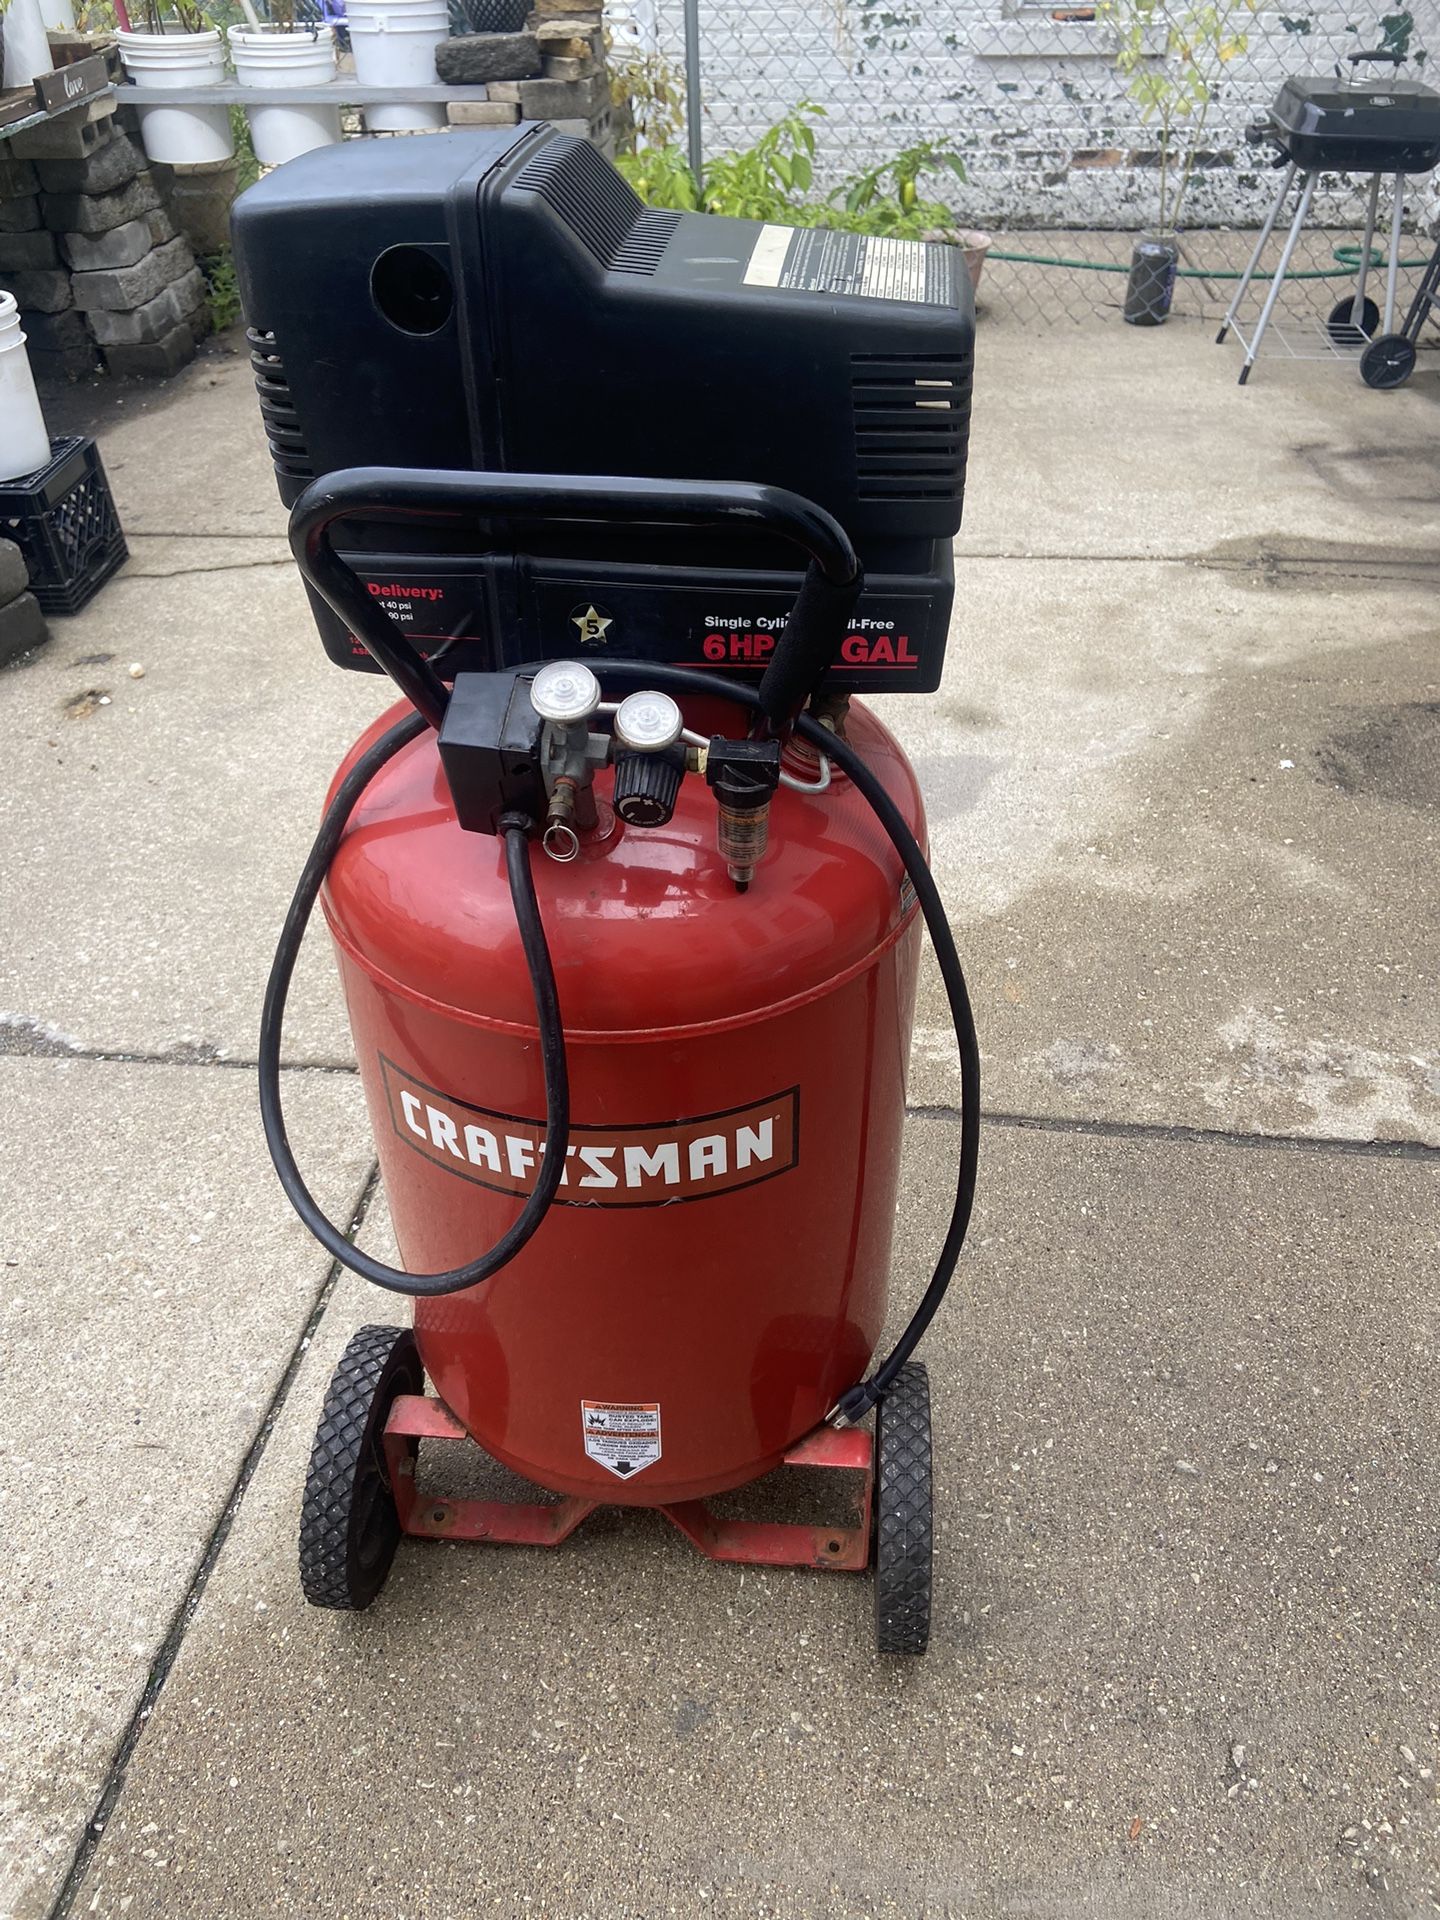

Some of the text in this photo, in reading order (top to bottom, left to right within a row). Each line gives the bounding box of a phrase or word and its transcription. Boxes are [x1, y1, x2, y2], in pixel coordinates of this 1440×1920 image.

[64, 73, 84, 98] love
[366, 583, 444, 600] Delivery:
[386, 601, 397, 609] 40
[398, 602, 412, 611] psi
[388, 612, 414, 621] 90 psi
[704, 616, 751, 629] Single
[846, 618, 895, 630] il-Free
[586, 619, 600, 635] 5
[840, 635, 918, 663] GAL
